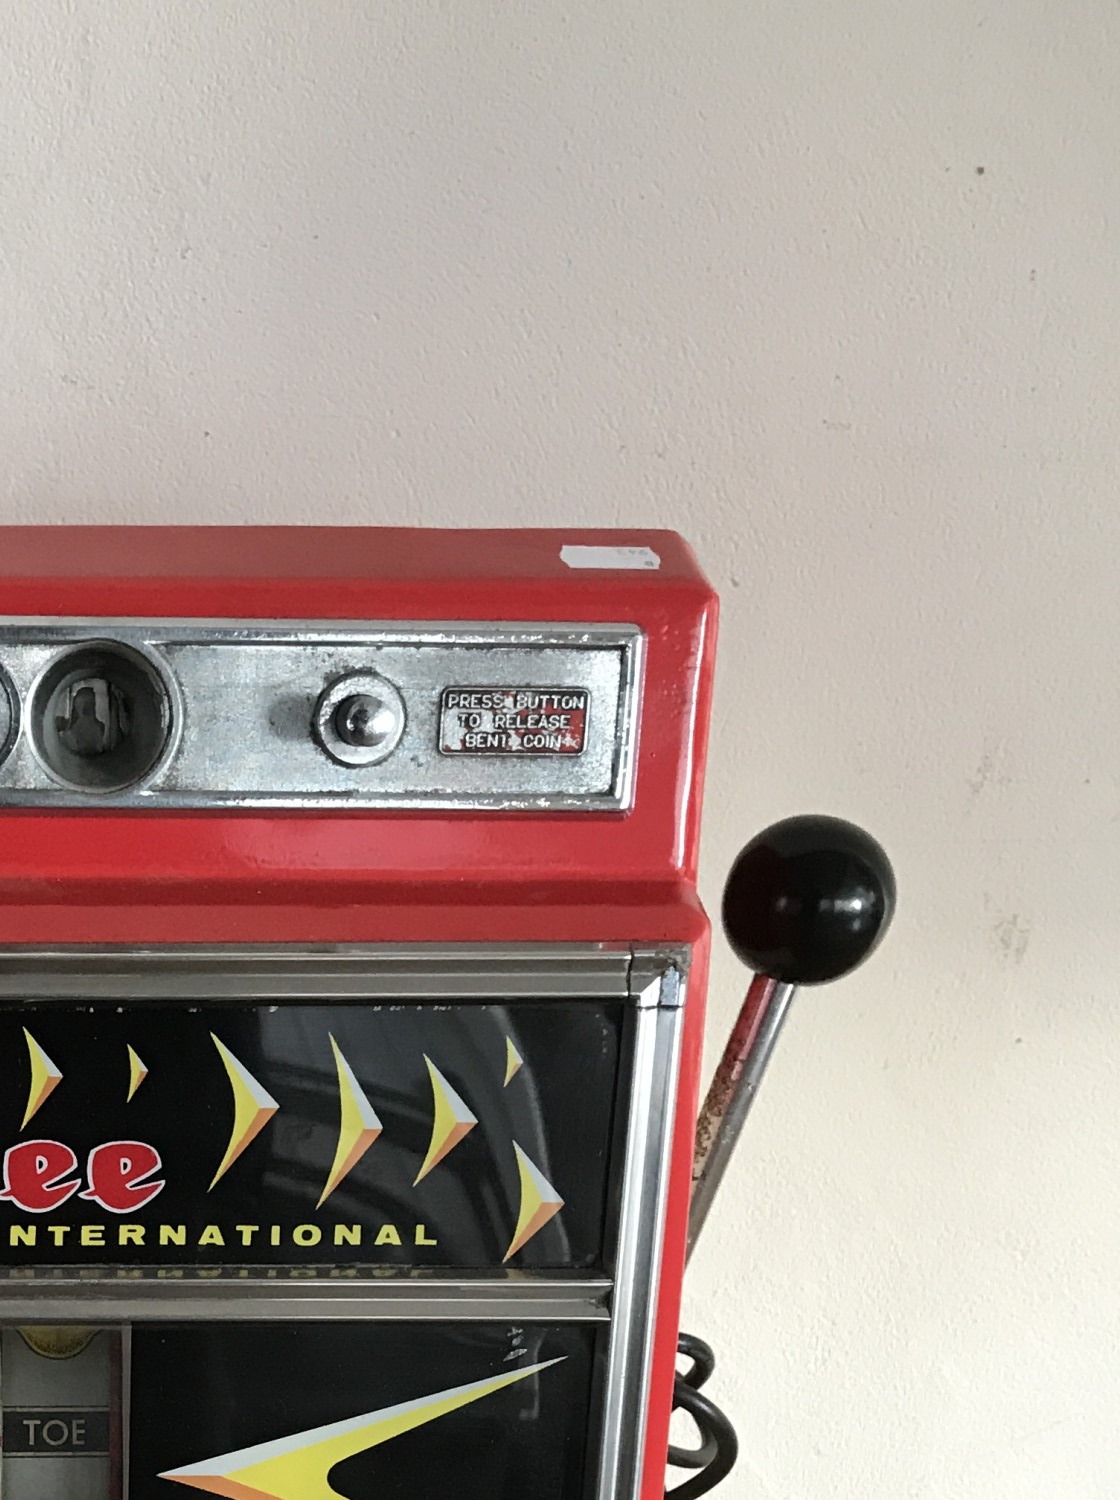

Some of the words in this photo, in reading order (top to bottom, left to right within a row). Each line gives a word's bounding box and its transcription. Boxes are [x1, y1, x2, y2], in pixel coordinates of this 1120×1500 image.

[448, 693, 503, 709] PRESS
[516, 694, 584, 709] BUTTON
[458, 713, 480, 728] TO
[494, 714, 571, 729] RELEASE
[465, 733, 506, 748] BENT
[523, 734, 562, 748] COIN
[23, 1420, 86, 1446] TOE
